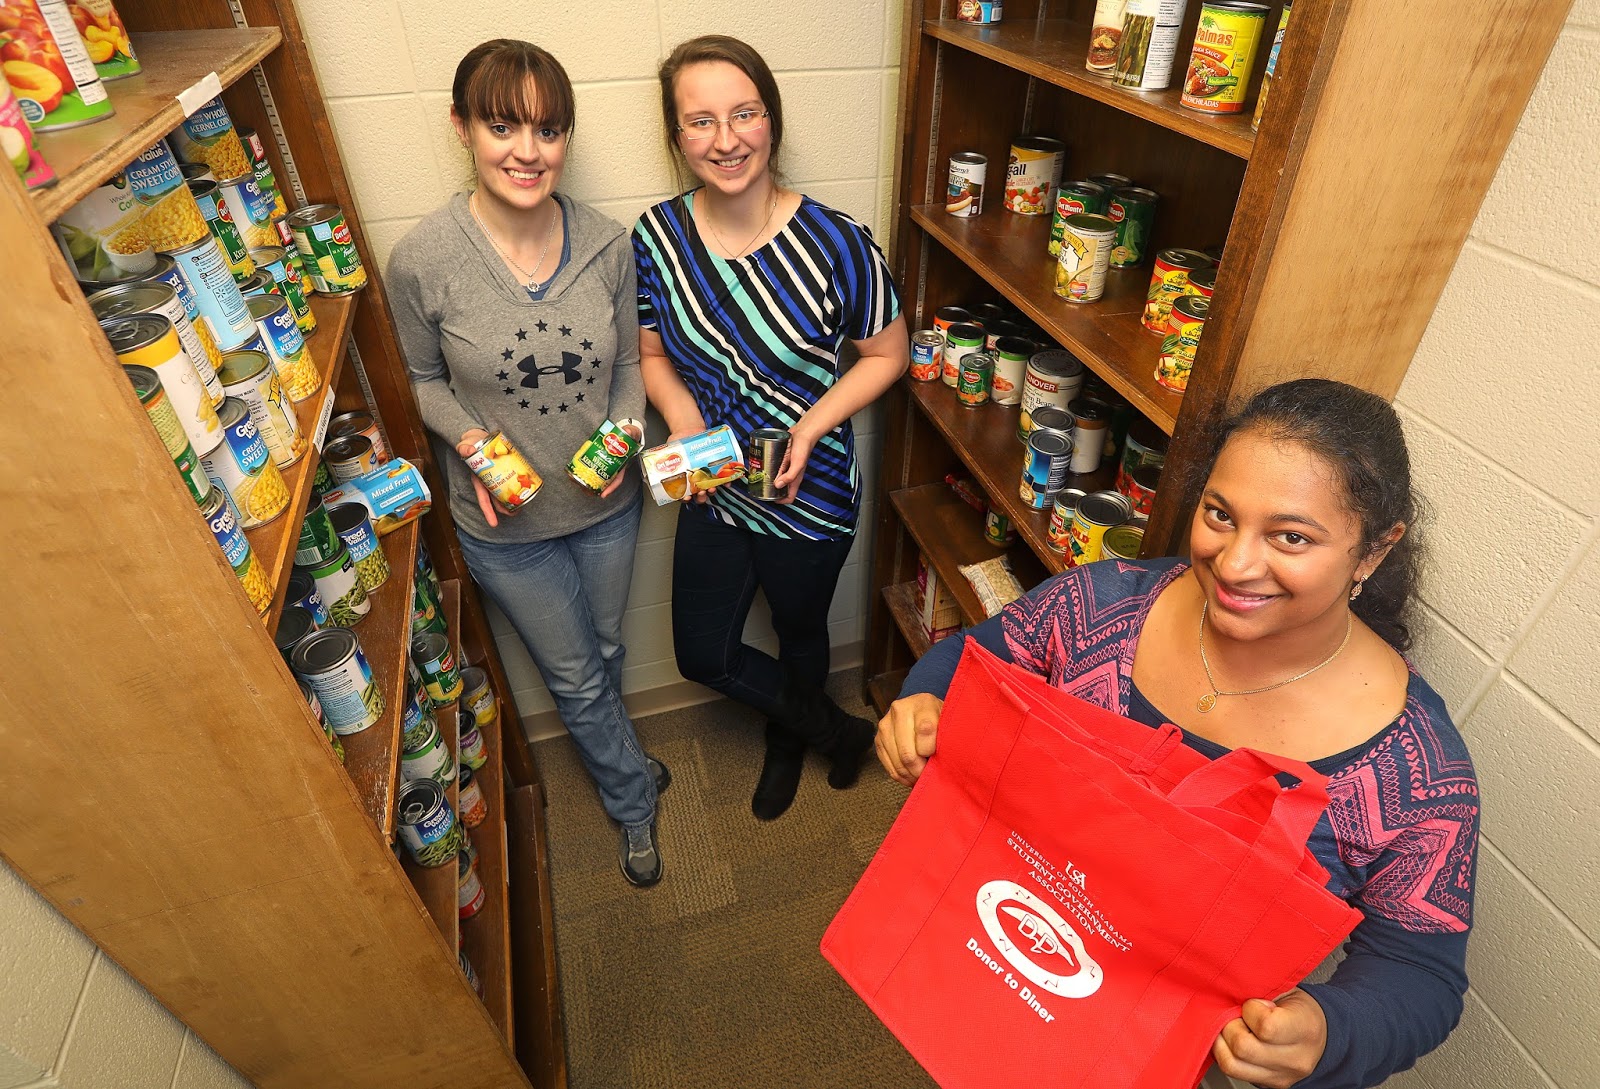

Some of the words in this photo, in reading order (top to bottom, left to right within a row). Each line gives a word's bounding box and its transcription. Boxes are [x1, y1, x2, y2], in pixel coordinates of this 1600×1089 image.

[190, 121, 218, 134] KERNEL
[130, 164, 161, 180] CREAM
[1006, 163, 1027, 180] g-all
[131, 173, 165, 191] SWEET
[1064, 204, 1083, 214] Monte
[371, 483, 395, 499] Mixed
[394, 475, 411, 488] Fruit
[227, 541, 246, 563] ERNEL
[353, 547, 371, 560] PEAS
[423, 806, 446, 828] Great
[423, 829, 438, 839] CUT
[1007, 837, 1056, 883] STUDENT
[1055, 881, 1131, 953] GOVERNMENT
[1011, 830, 1056, 871] UNIVERSITY
[1057, 871, 1068, 881] OF
[1068, 881, 1094, 909] SOUTH
[1094, 909, 1134, 947] ALABAMA
[1028, 870, 1095, 936] ASSOCIATION
[966, 937, 1005, 976] Donor
[1004, 972, 1020, 990] to
[1018, 986, 1056, 1024] Diner
